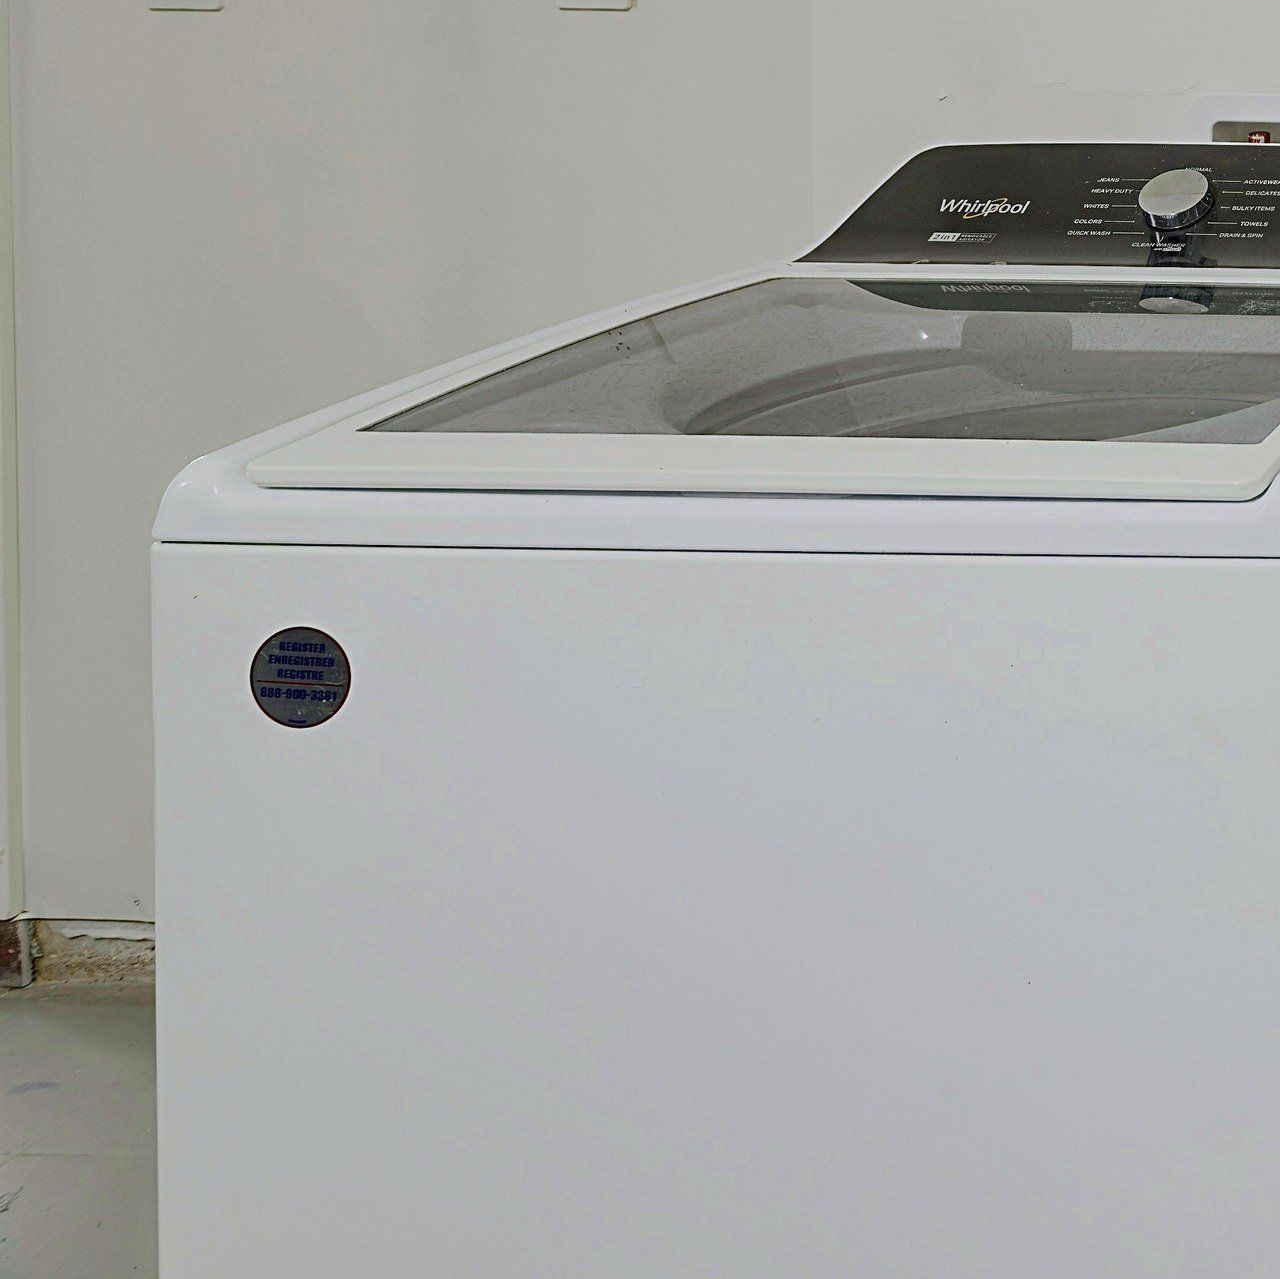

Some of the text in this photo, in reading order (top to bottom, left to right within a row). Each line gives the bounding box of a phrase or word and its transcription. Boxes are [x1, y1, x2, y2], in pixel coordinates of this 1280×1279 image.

[940, 198, 1031, 218] Whirlpool
[279, 642, 326, 653] REGISTER
[268, 655, 335, 668] ENREGISTRER
[277, 669, 324, 680] REGISTRE
[260, 687, 337, 701] 888-900-3381
